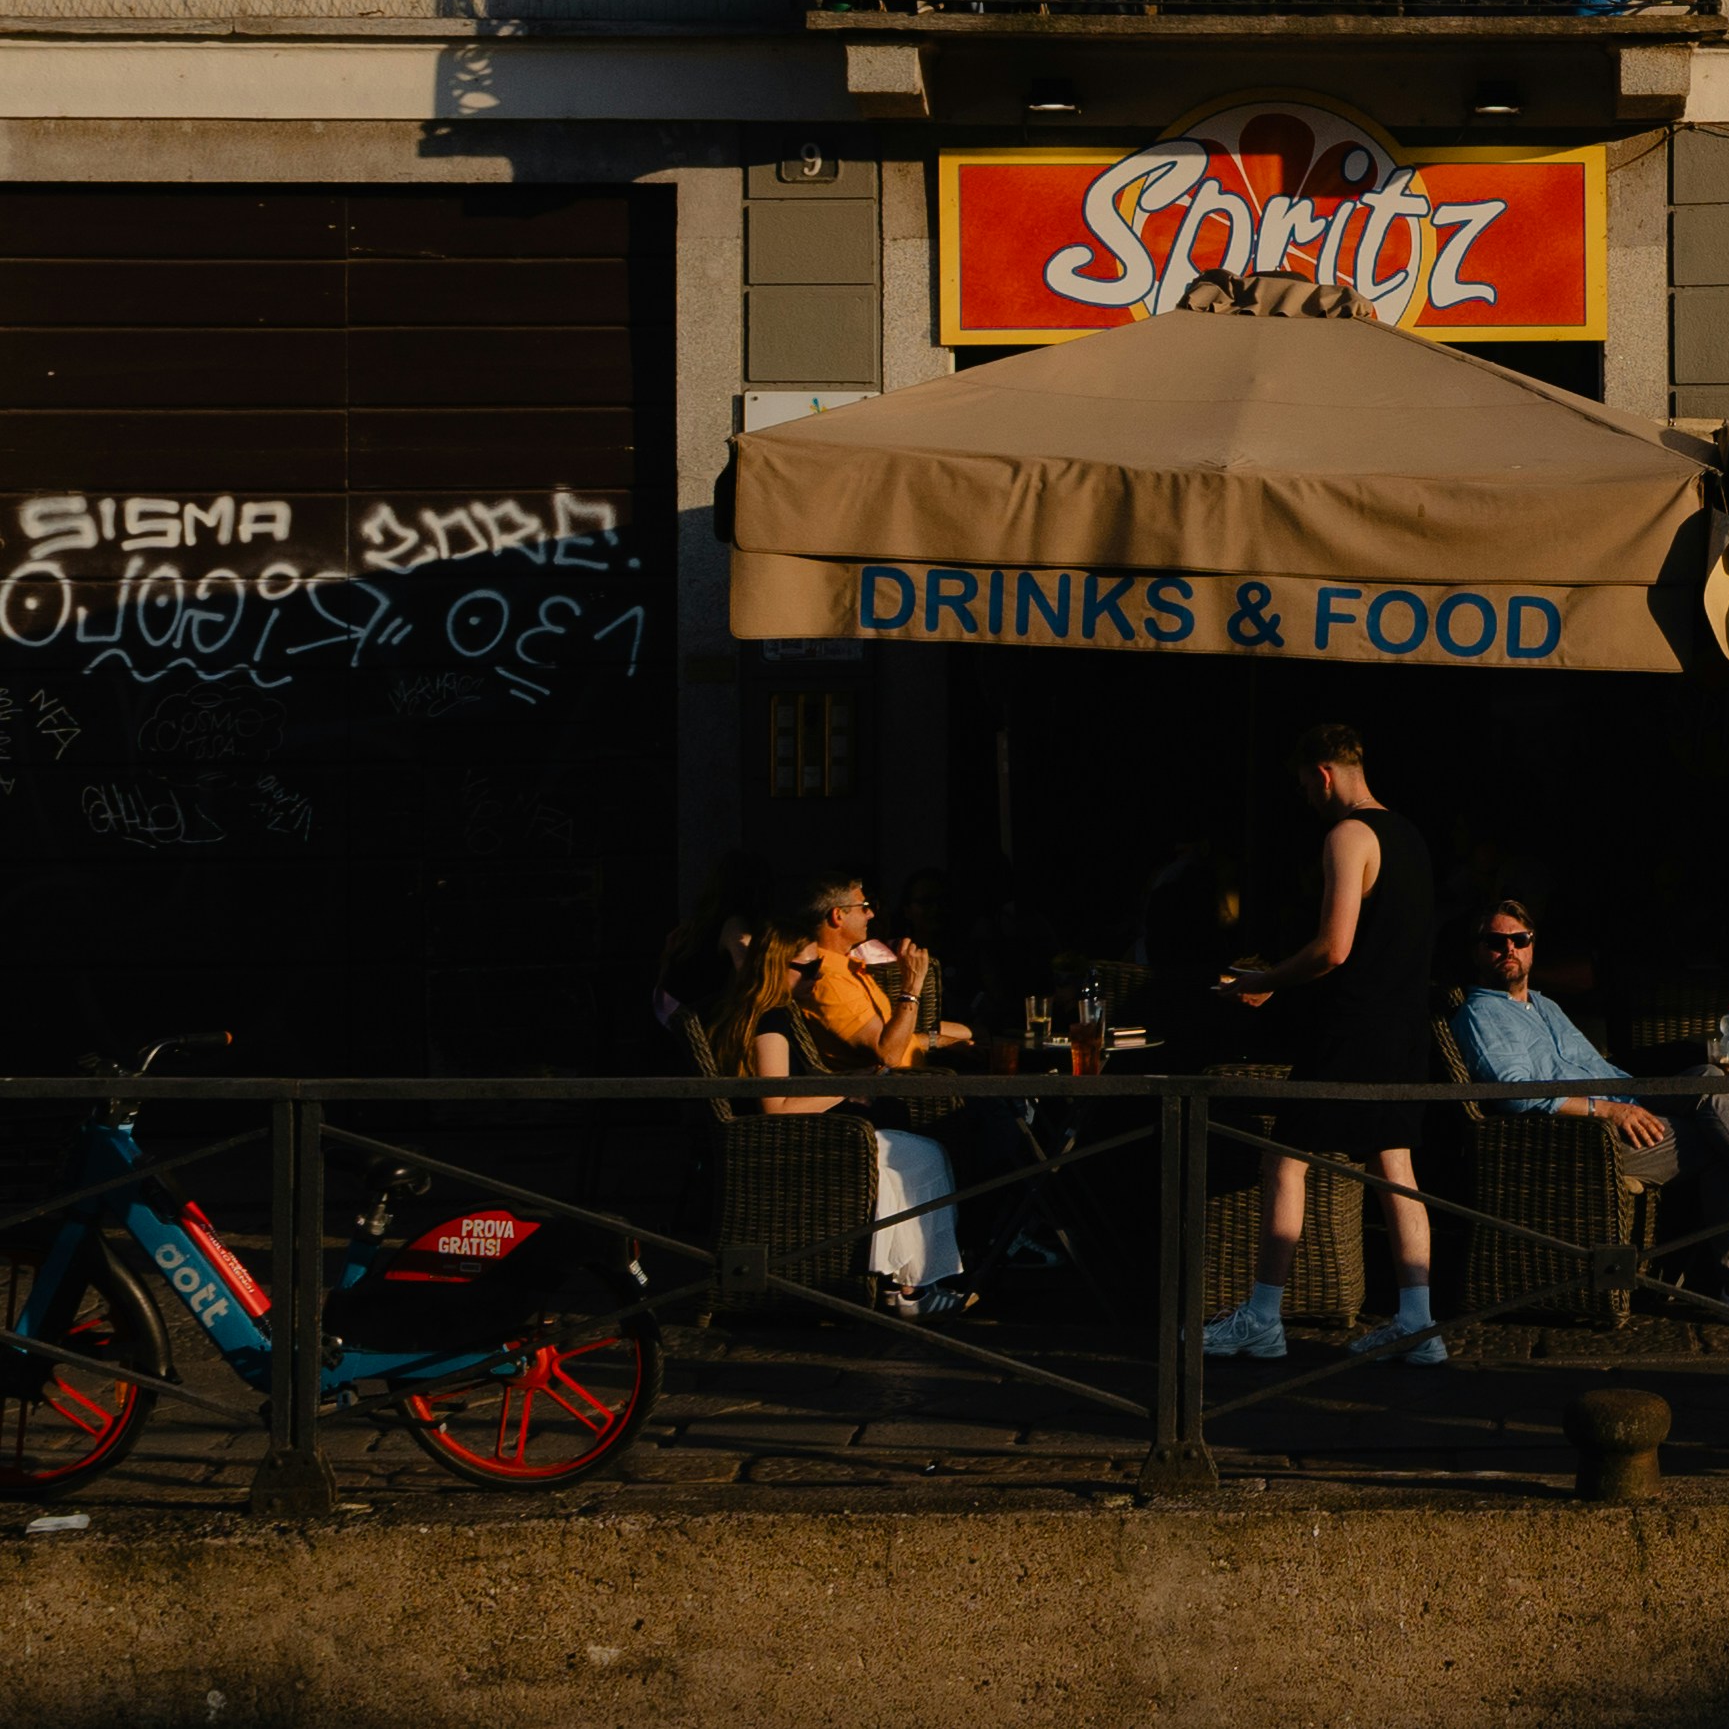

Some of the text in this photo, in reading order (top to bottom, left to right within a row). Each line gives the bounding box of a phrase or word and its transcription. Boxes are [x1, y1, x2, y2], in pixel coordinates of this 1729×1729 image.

[800, 142, 823, 177] 9
[1044, 137, 1508, 316] Spritz
[17, 494, 292, 560] SISMA
[859, 564, 1562, 660] DRINKS & FOOD
[438, 1236, 502, 1257] GRATIS!
[461, 1219, 515, 1239] PROVA
[155, 1243, 230, 1328] dott
